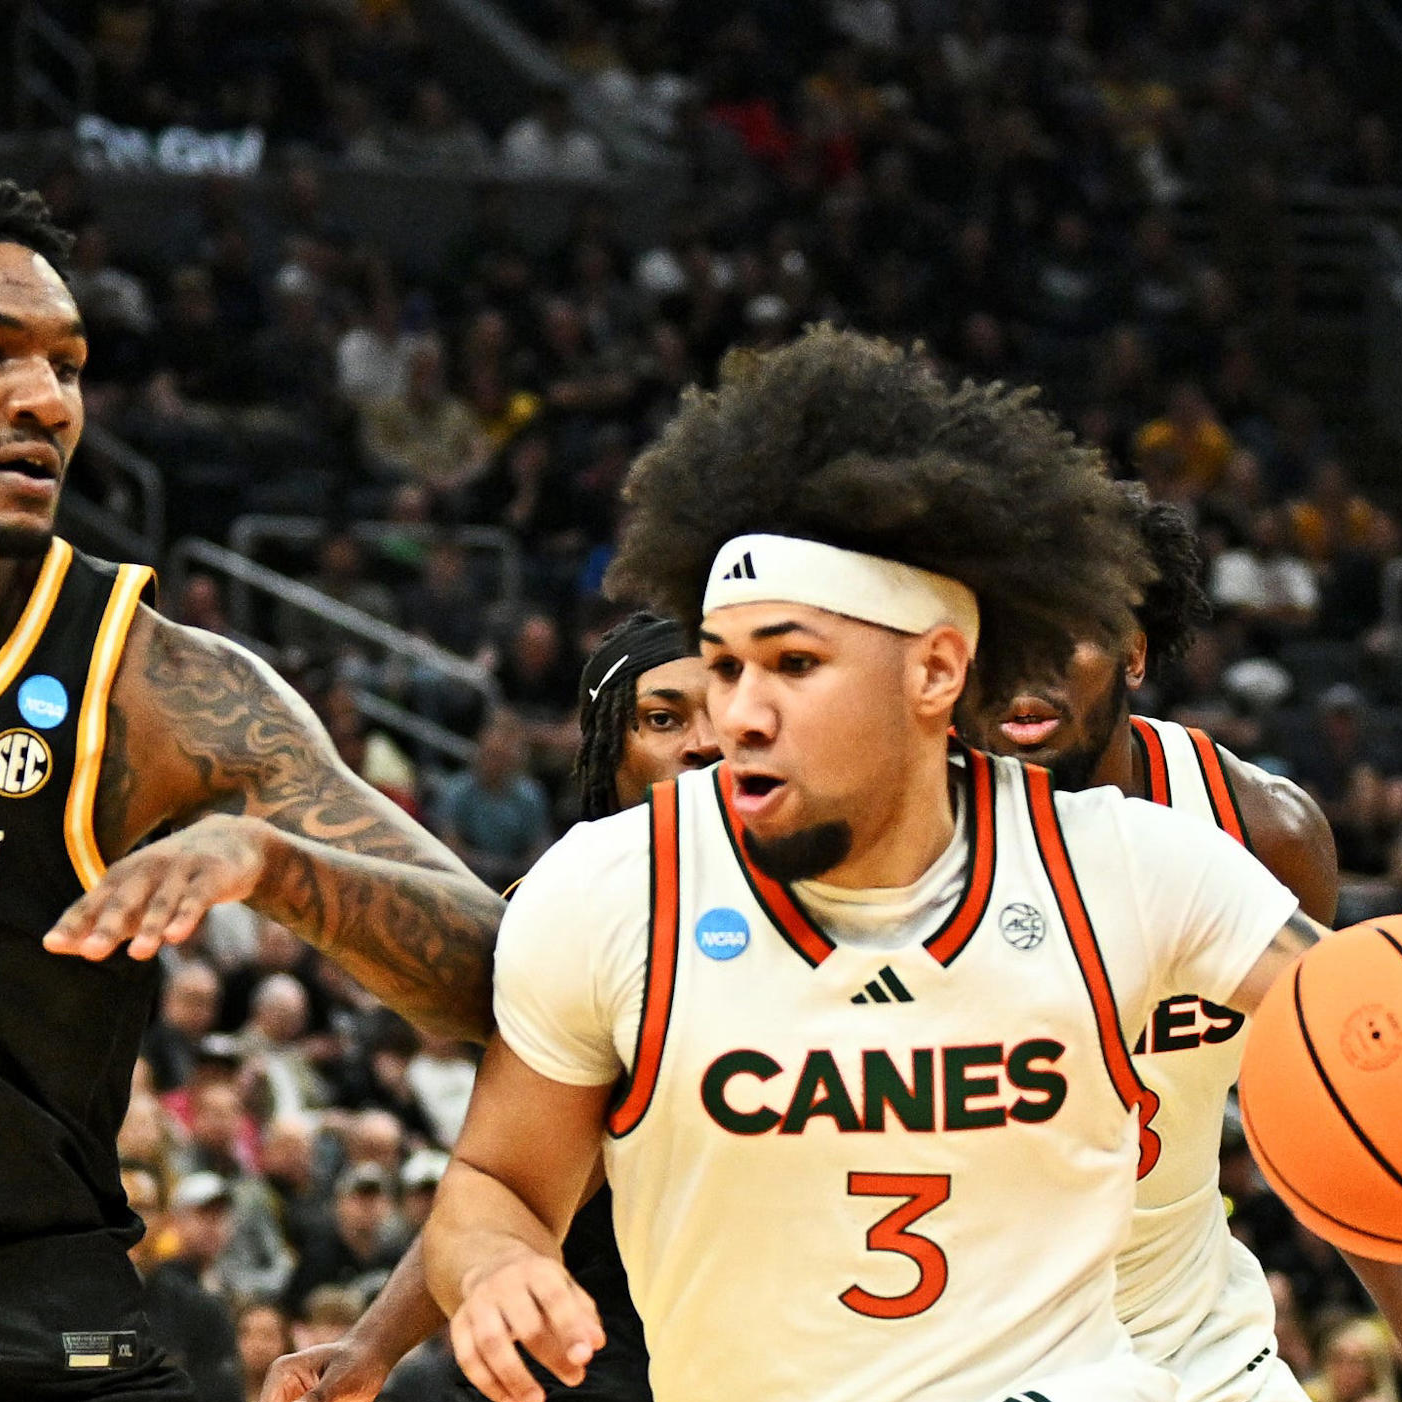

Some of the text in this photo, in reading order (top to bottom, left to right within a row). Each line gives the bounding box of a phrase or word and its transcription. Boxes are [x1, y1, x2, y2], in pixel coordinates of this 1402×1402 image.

[25, 697, 65, 718] NCAA
[700, 931, 746, 948] NCAA
[700, 1038, 1068, 1136] CANES
[838, 1170, 952, 1320] 3
